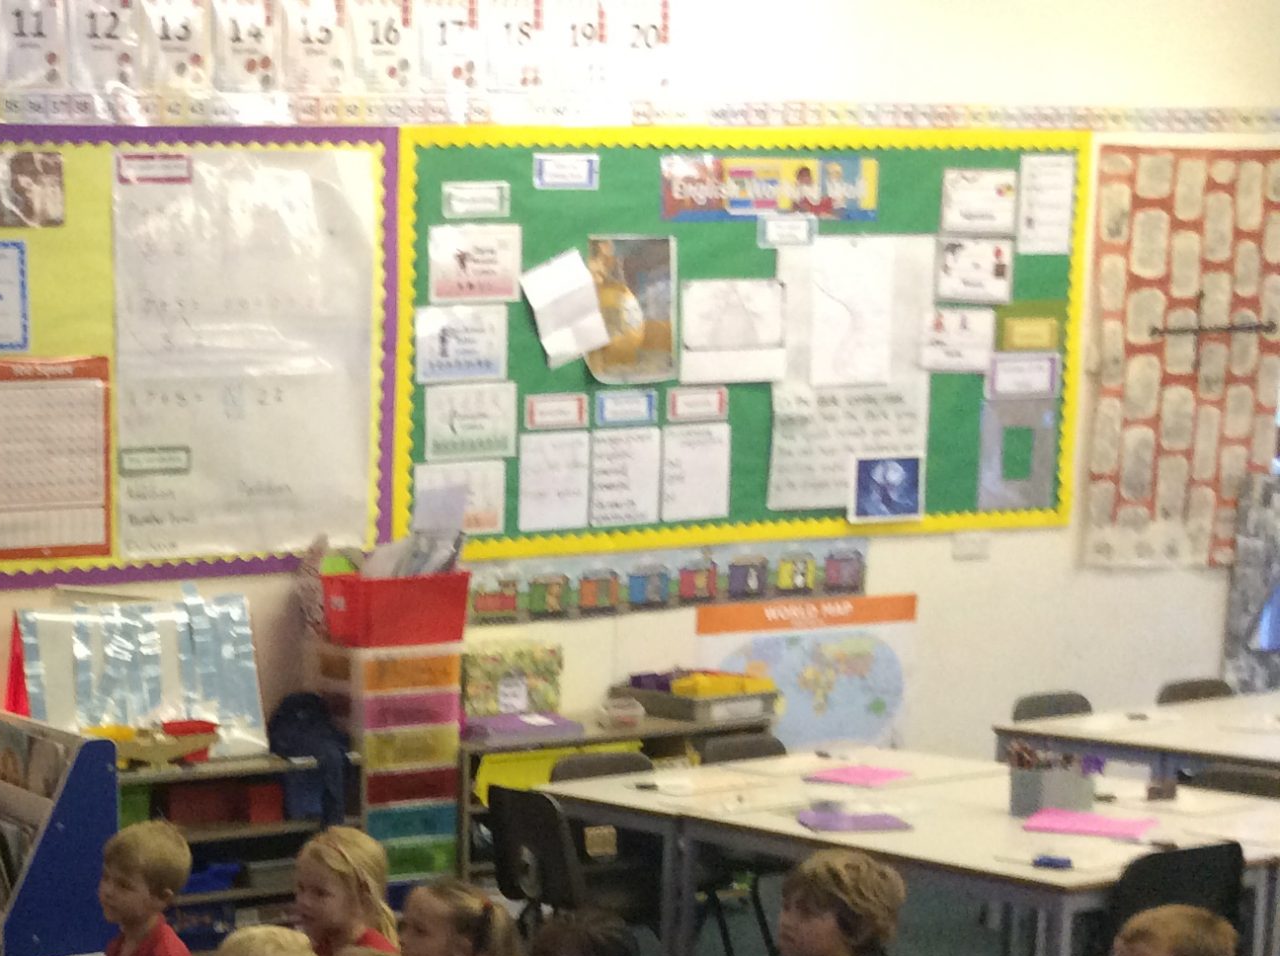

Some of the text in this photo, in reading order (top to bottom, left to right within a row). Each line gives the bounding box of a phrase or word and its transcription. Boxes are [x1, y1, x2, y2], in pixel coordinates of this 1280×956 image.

[12, 9, 46, 39] 11
[86, 11, 120, 42] 12
[230, 17, 265, 46] 14
[369, 17, 400, 47] 16
[570, 22, 597, 48] 19
[630, 23, 660, 49] 20
